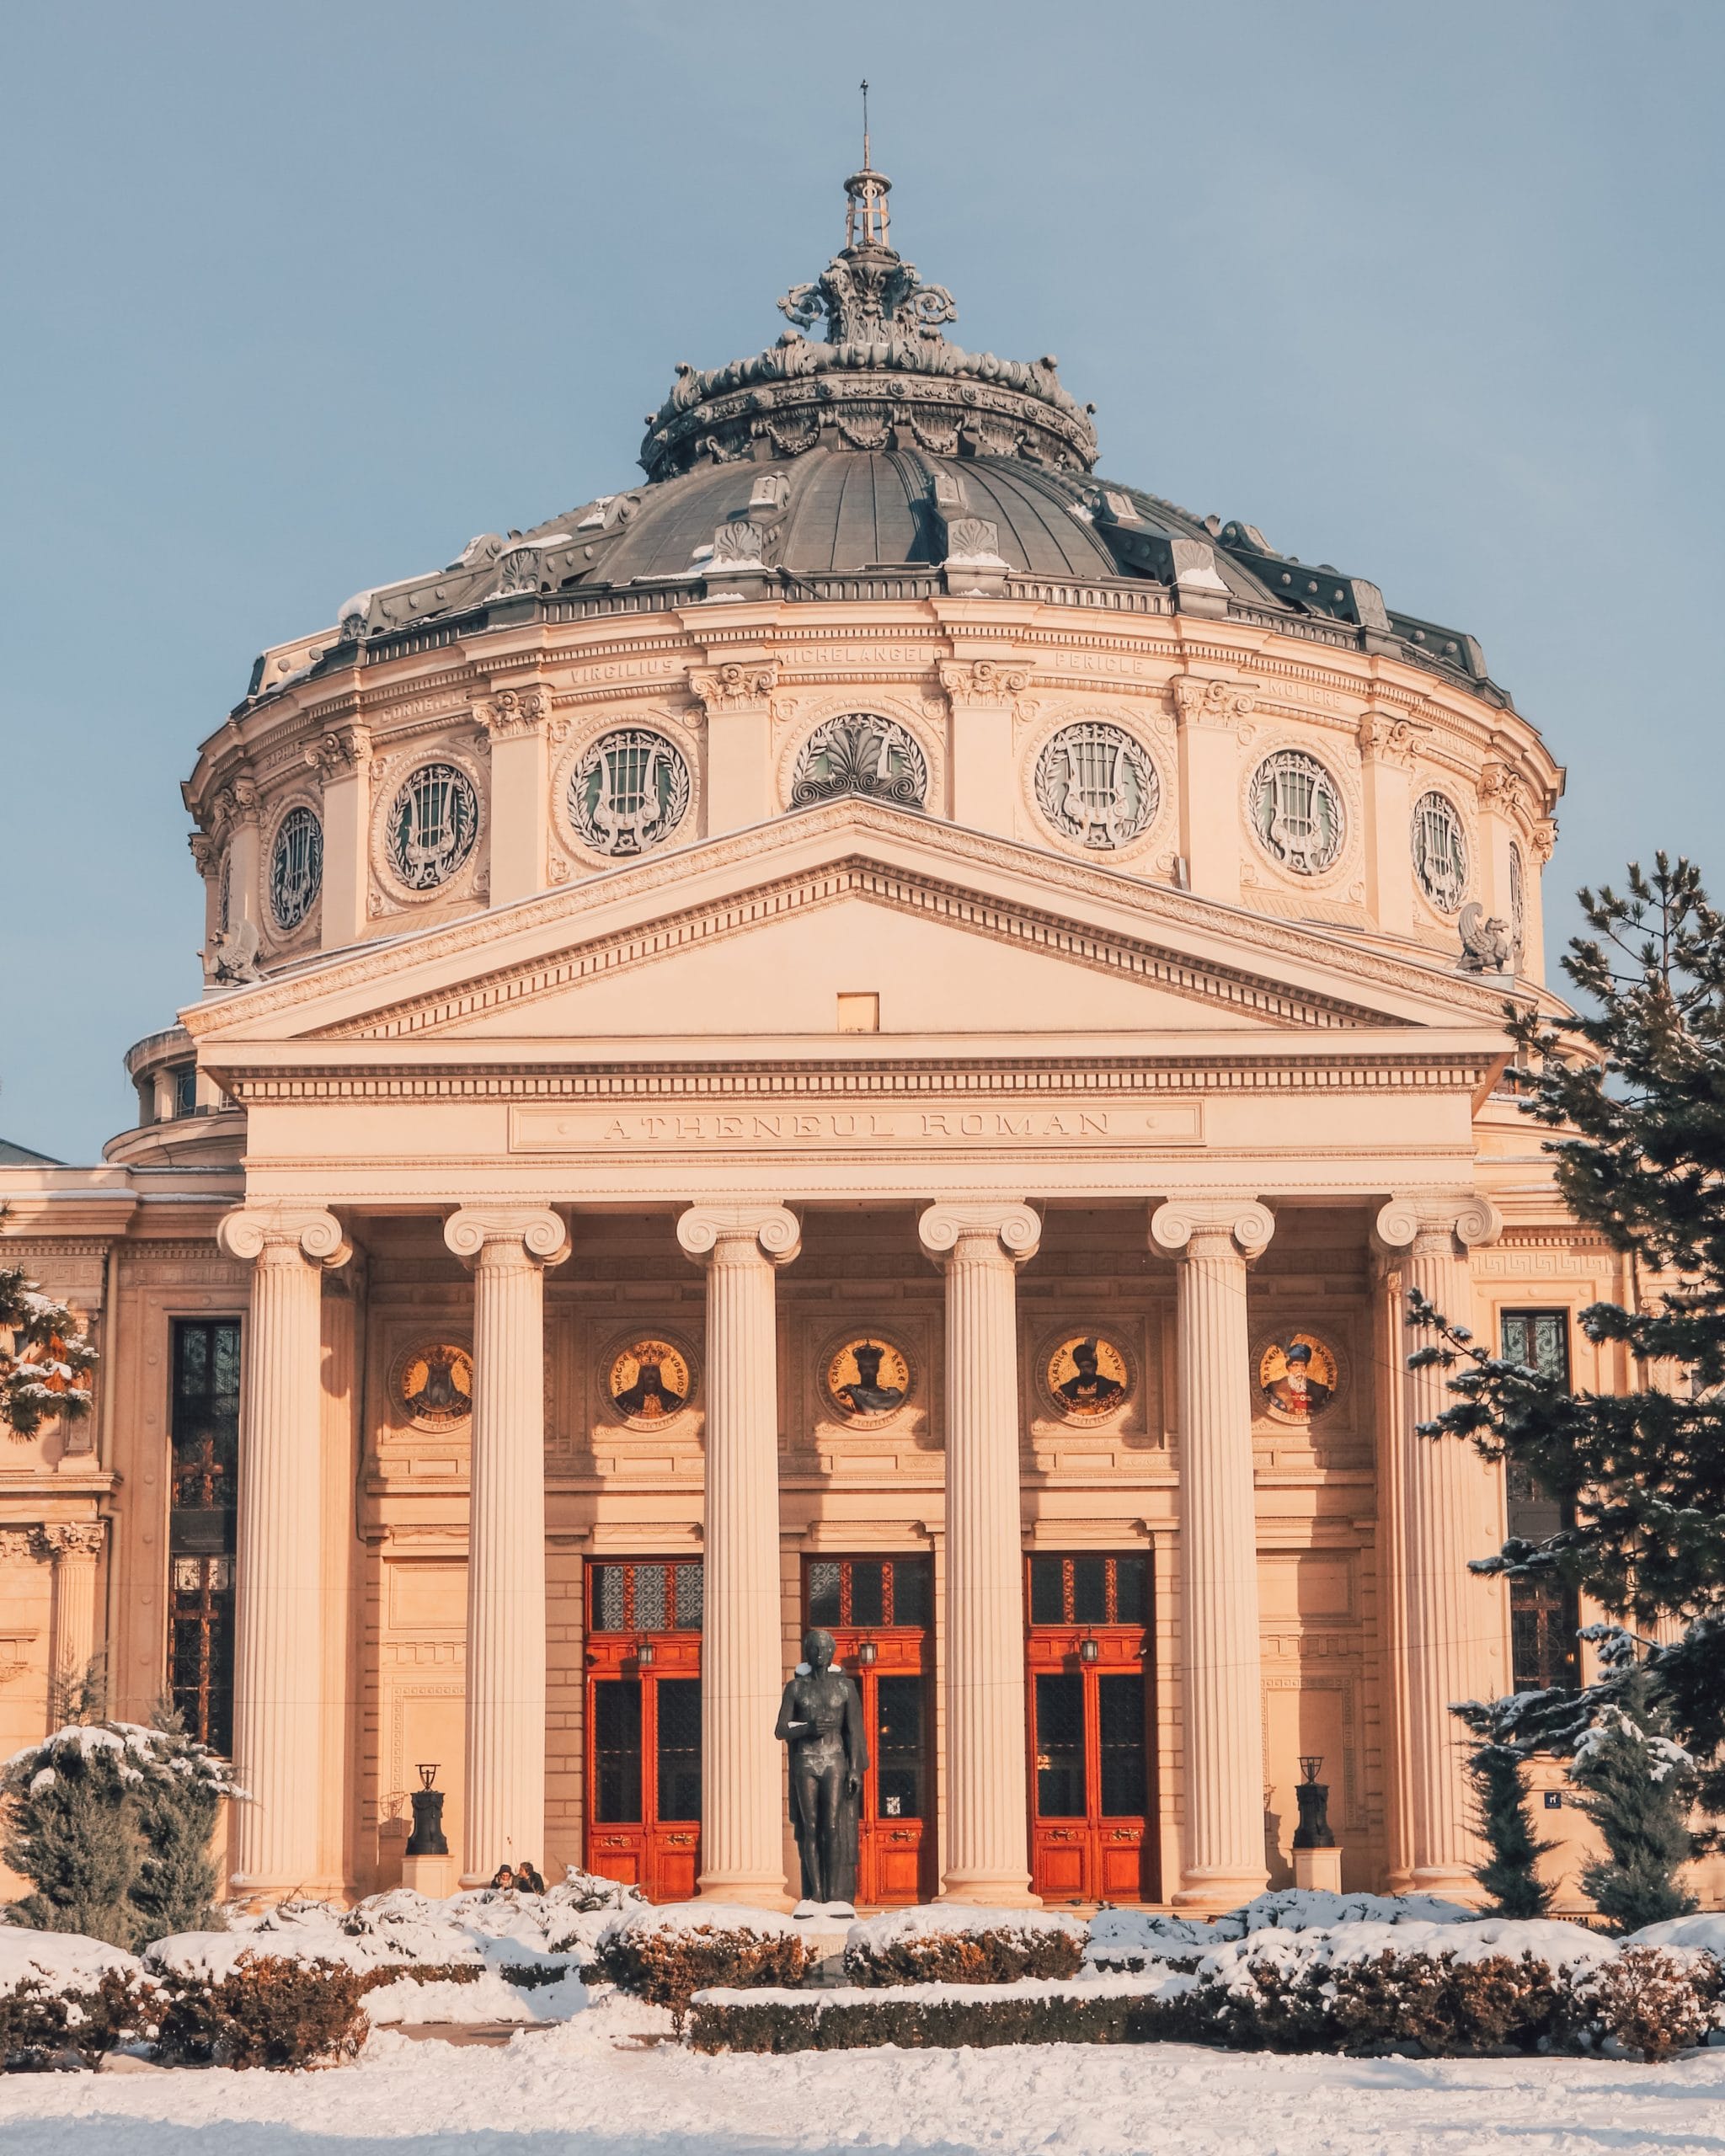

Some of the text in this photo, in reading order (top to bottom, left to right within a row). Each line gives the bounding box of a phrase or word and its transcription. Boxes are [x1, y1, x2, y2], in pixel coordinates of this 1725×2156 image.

[773, 645, 944, 664] MICHELANGELO
[1055, 652, 1144, 675] PERICLE
[571, 659, 674, 684] VIRGILIUS
[382, 687, 473, 723] CORNEILLE
[1268, 679, 1342, 709] MOLIERE
[603, 1113, 1112, 1141] ATHENEUL ROMAN
